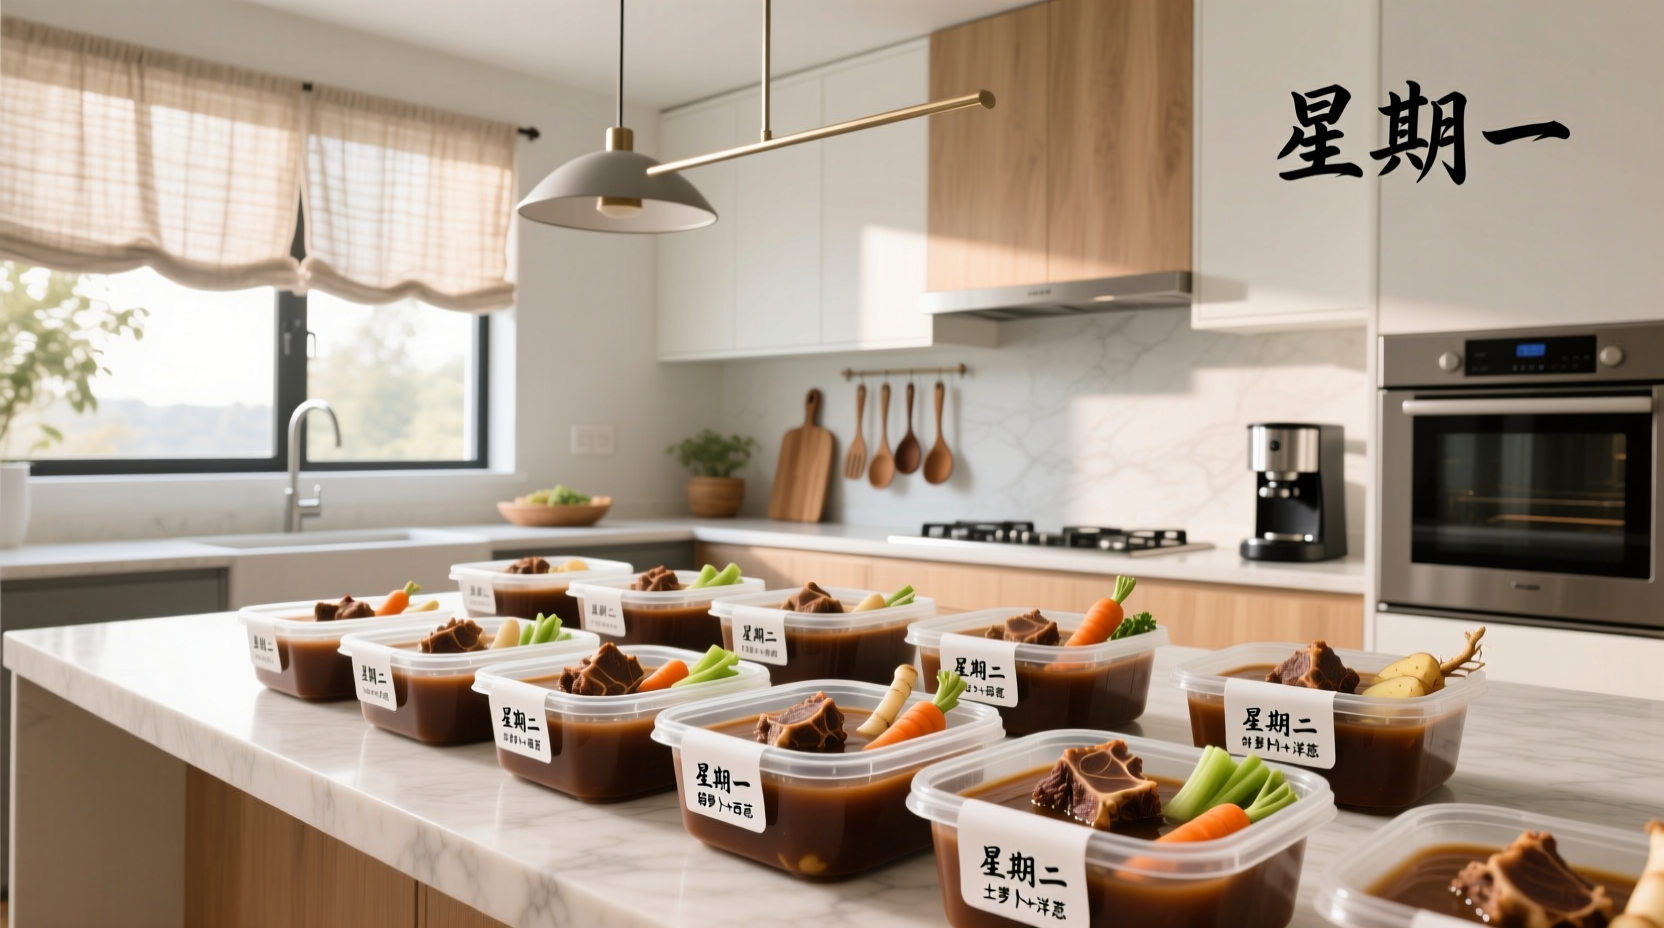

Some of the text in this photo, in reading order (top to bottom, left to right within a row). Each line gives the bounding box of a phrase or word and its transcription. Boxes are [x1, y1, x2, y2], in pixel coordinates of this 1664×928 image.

[1277, 80, 1570, 185] 星期一
[501, 706, 540, 733] 星期二
[1242, 707, 1317, 737] 星期二
[696, 762, 751, 794] 星期一
[980, 845, 1067, 888] 星期二
